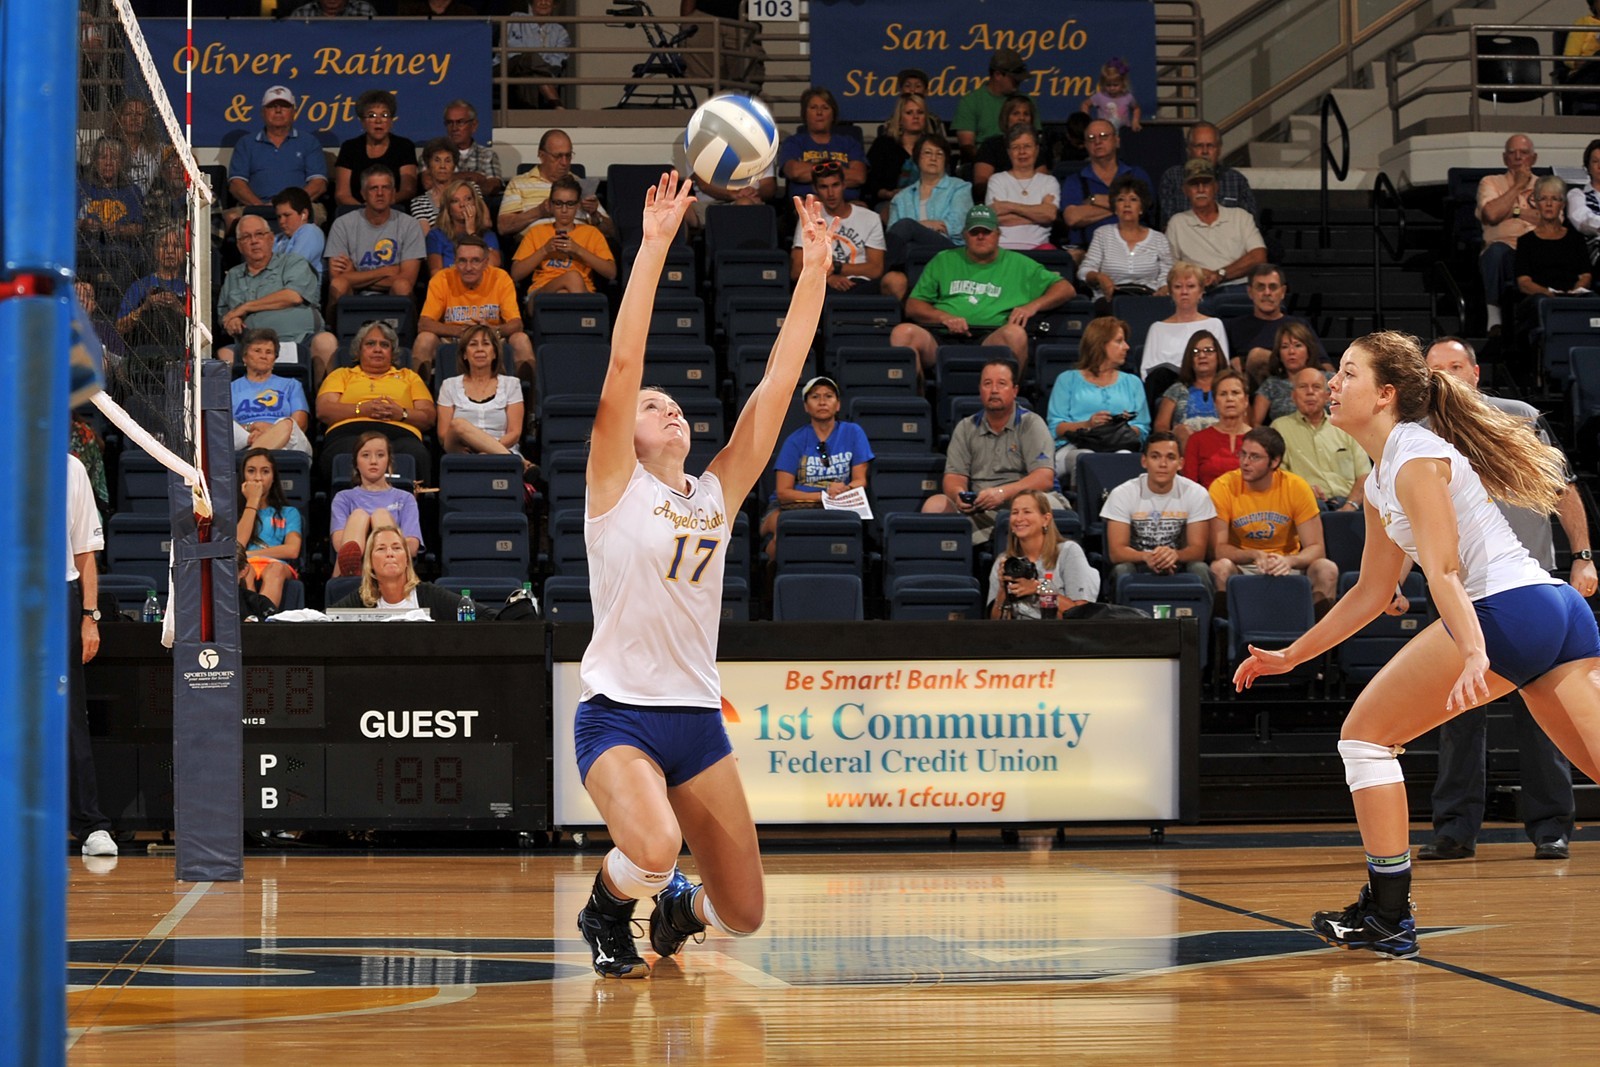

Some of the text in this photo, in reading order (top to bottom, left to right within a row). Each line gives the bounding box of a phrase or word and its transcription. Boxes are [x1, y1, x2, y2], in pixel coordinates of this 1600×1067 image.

[753, 0, 792, 17] 103
[882, 19, 1088, 60] San Angelo
[172, 42, 451, 85] Oliver, Rainey
[843, 66, 1101, 97] Stadar Tim
[223, 94, 253, 122] &
[838, 225, 867, 249] AGLE
[653, 500, 698, 530] Angelo
[665, 534, 721, 585] 17
[785, 669, 1056, 690] Be Smart! Bank Smart!
[359, 710, 479, 738] GUEST
[753, 701, 1090, 748] 1st Community
[260, 754, 278, 776] P
[768, 749, 1059, 773] Federal Credit Union
[261, 787, 279, 809] B
[826, 787, 1006, 812] www.1cfcu.org
